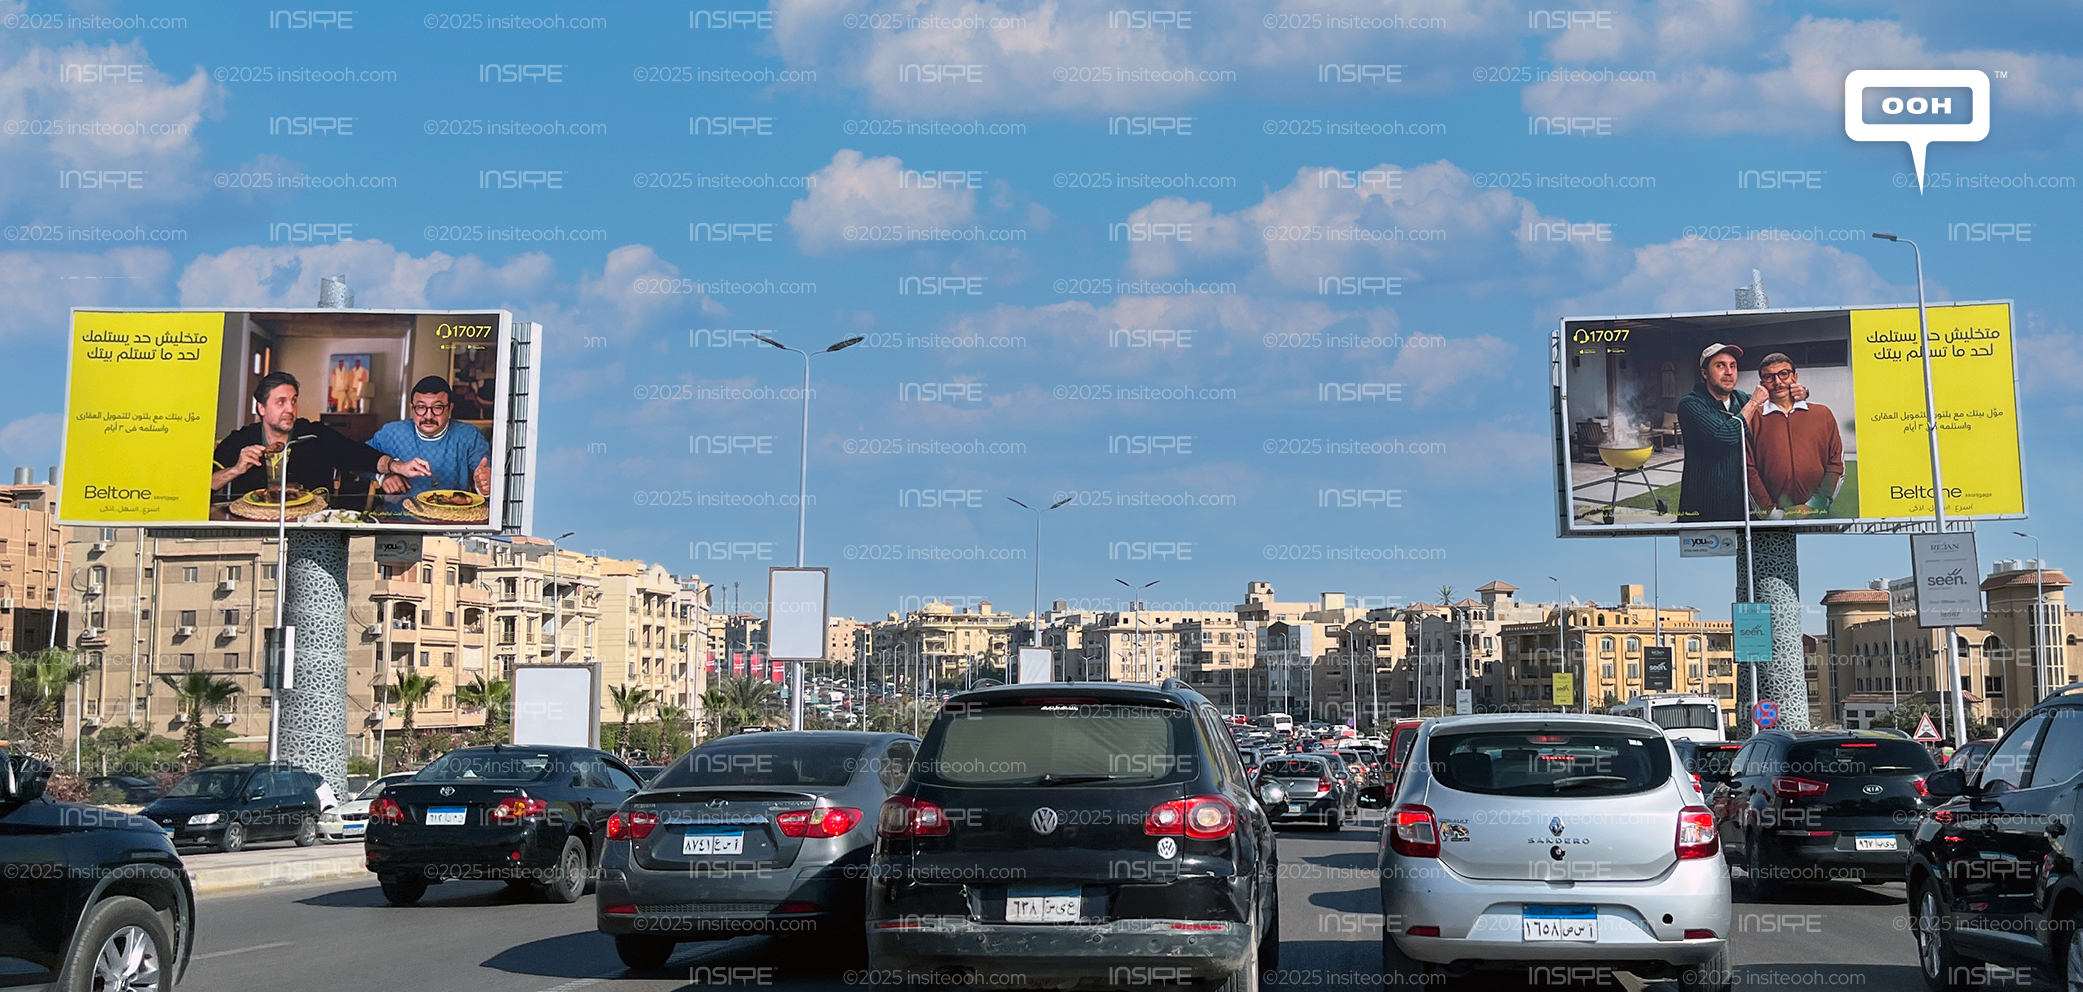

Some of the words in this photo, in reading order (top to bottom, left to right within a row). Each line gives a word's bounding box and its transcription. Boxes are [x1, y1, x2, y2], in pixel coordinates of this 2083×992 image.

[82, 330, 130, 346] يستلمك
[453, 325, 492, 338] 17077
[1590, 330, 1629, 342] 17077
[1866, 330, 1916, 344] يستلمك
[1945, 327, 2000, 343] متخليش
[133, 334, 151, 344] حد
[156, 331, 208, 346] متخليش
[87, 347, 112, 362] بيتك
[116, 348, 157, 362] تستلم
[161, 348, 173, 360] ما
[177, 349, 200, 360] لحد
[1874, 347, 1901, 362] بيتك
[1952, 345, 1965, 357] ما
[1970, 343, 1993, 356] لحد
[103, 412, 130, 421] للتمويل
[152, 414, 163, 423] مع
[84, 485, 152, 500] Beltone
[1526, 922, 1559, 936] ١٦٥٨
